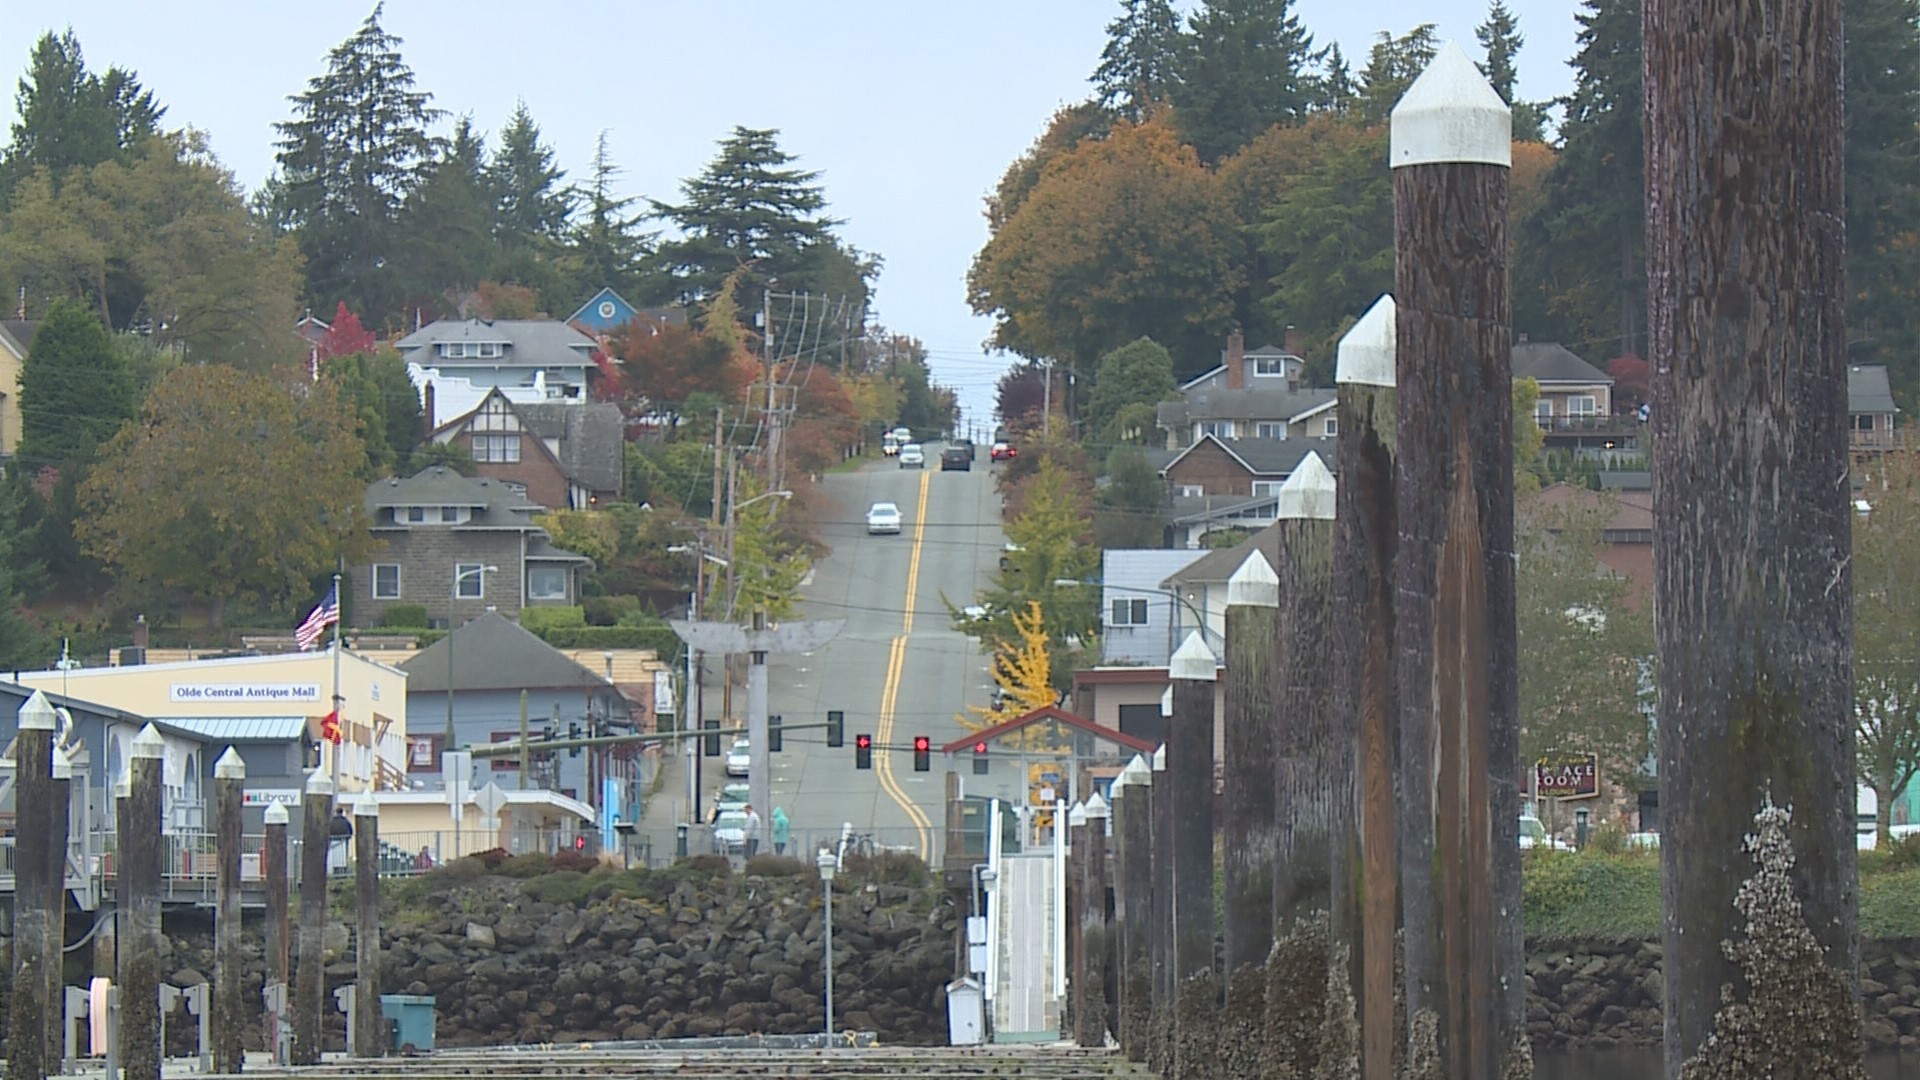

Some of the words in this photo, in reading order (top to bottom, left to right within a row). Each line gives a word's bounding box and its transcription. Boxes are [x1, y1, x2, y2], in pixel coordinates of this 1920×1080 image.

[176, 687, 202, 697] Olde
[204, 687, 244, 697] Central
[246, 687, 289, 698] Antique
[291, 687, 315, 697] Mall
